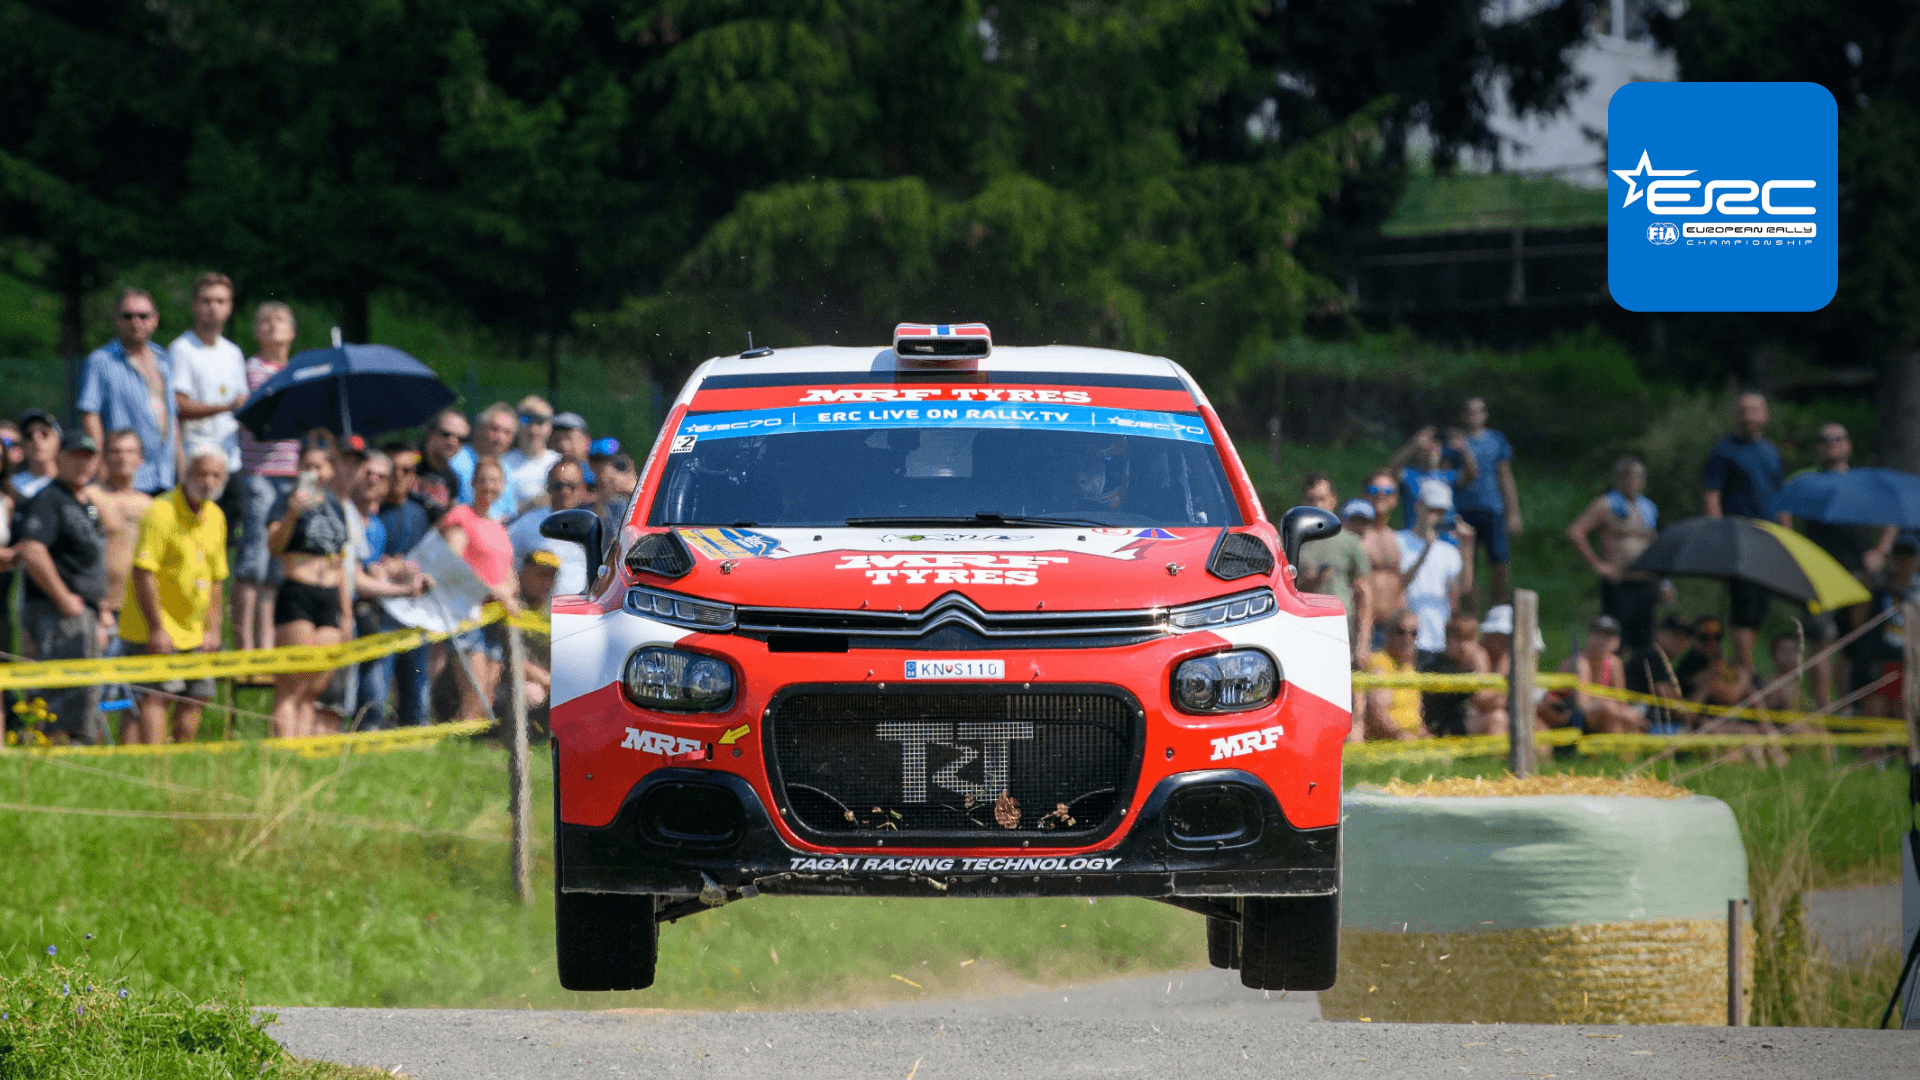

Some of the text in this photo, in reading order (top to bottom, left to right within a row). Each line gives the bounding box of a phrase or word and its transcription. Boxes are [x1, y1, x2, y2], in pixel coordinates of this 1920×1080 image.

[799, 388, 1092, 404] MRF TYRES
[818, 408, 1070, 422] ERC LIVE ON RALLY.TV
[835, 554, 1069, 570] MRF
[865, 569, 1039, 586] TYRES
[921, 663, 945, 676] KN
[954, 663, 997, 676] S110
[621, 727, 702, 756] MRF
[1210, 726, 1284, 761] MRF
[789, 857, 1122, 871] TAGAI RACING TECHNOLOGY
